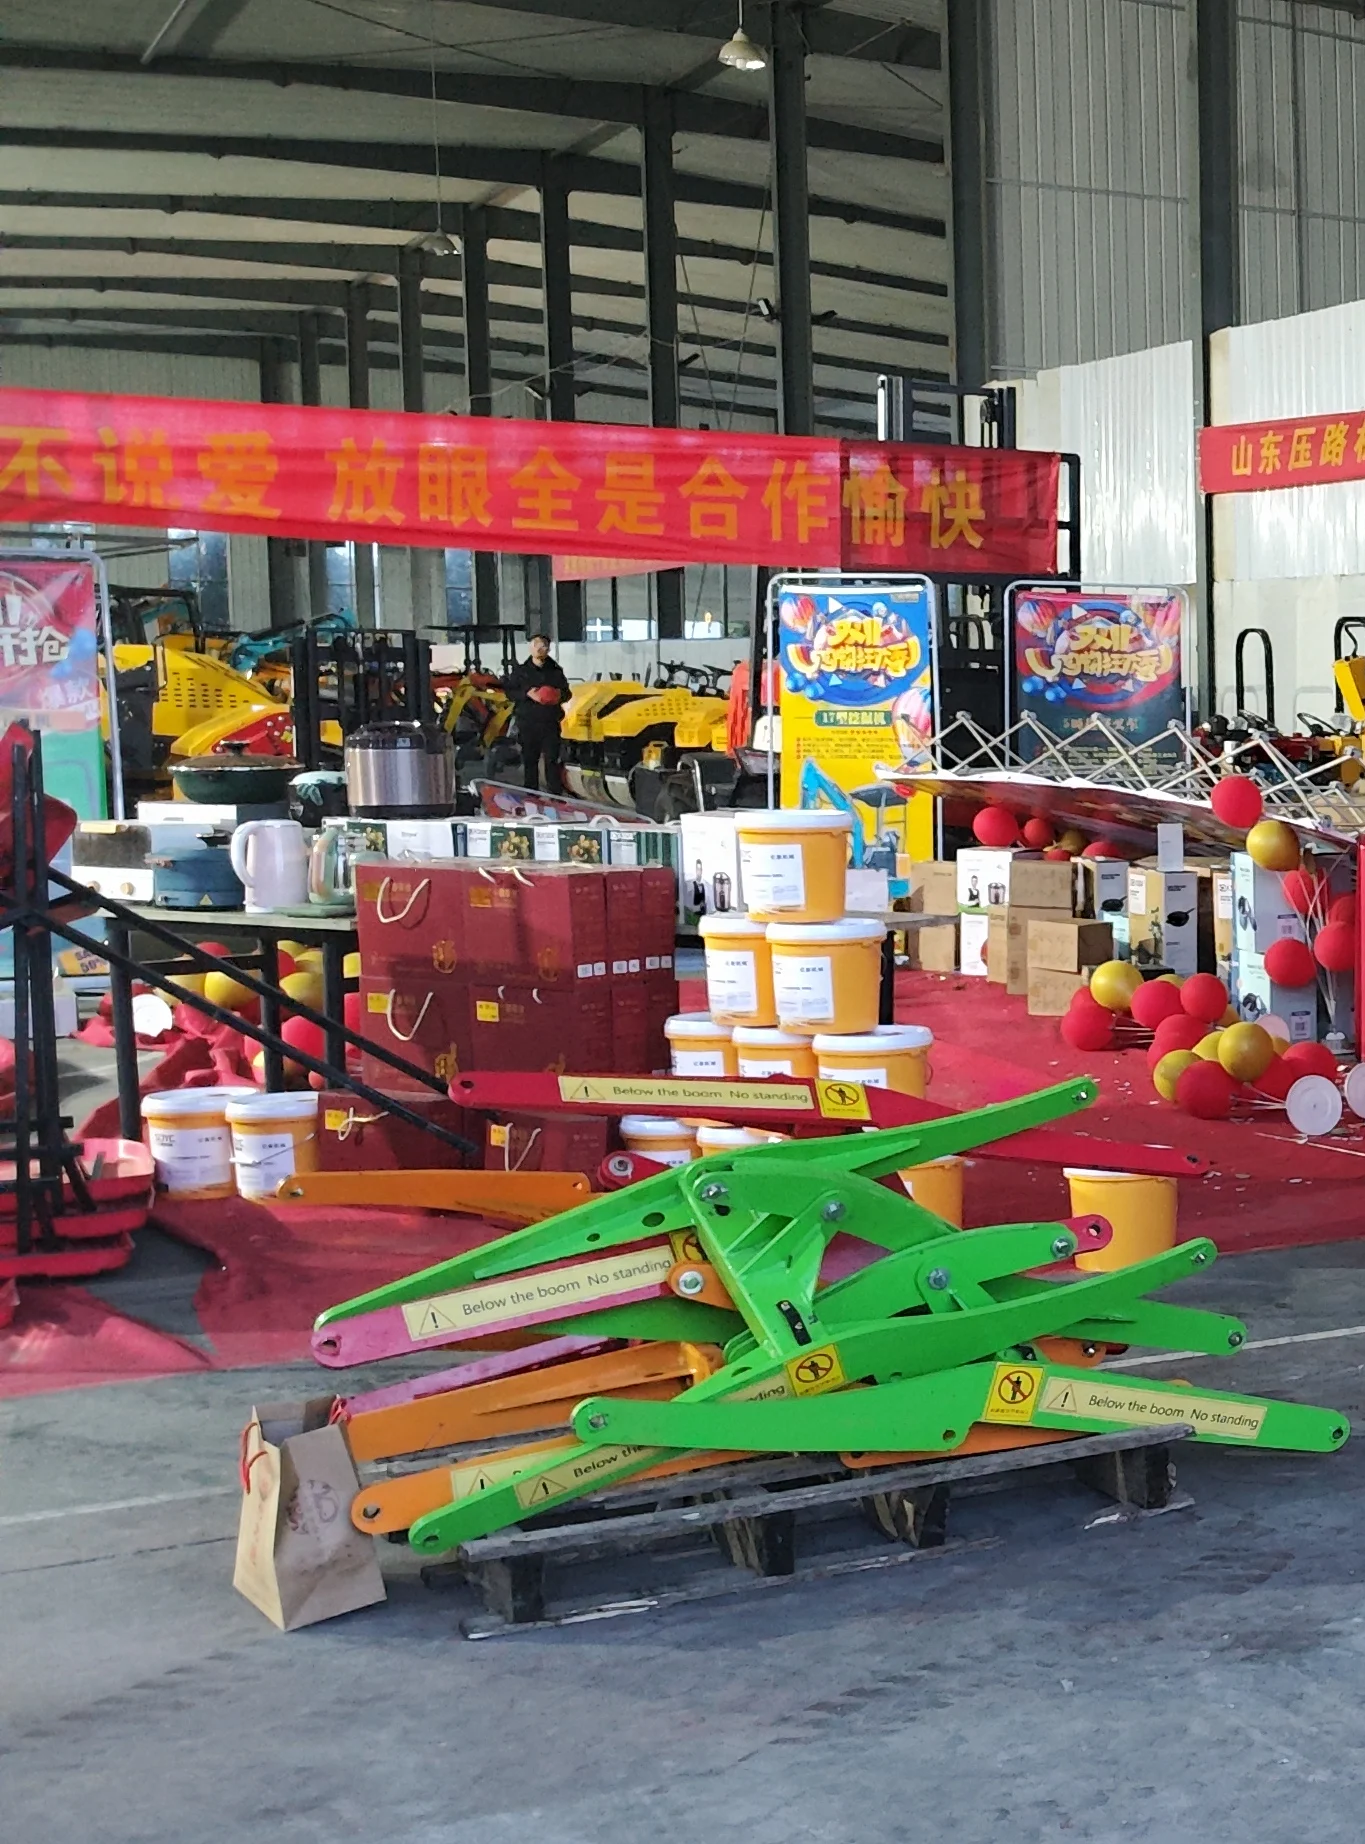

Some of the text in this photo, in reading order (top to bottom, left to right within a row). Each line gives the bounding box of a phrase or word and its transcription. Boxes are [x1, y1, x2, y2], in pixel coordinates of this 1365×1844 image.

[326, 435, 987, 550] 放眼全是合作愉快
[613, 1086, 809, 1104] Below the boom No standing
[462, 1258, 673, 1316] Below the boom No standing
[1088, 1394, 1260, 1431] Below the boom No standing
[573, 1453, 619, 1479] Below
